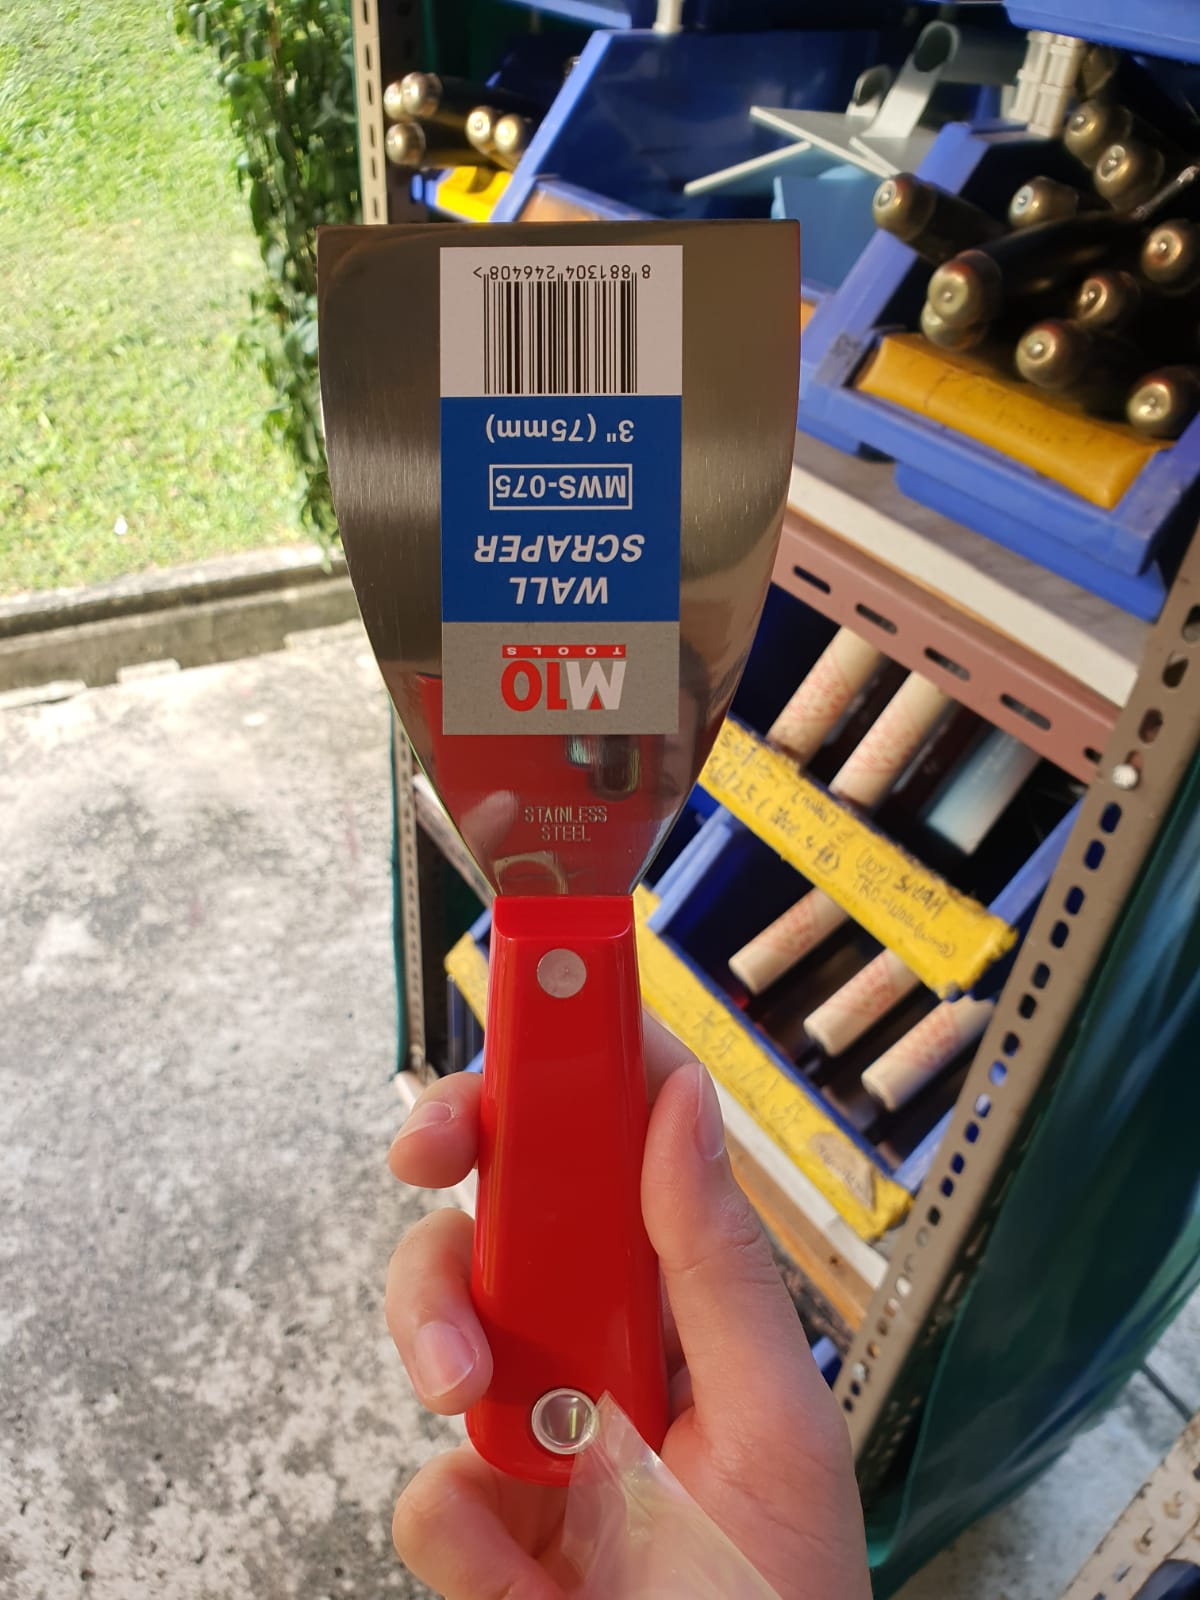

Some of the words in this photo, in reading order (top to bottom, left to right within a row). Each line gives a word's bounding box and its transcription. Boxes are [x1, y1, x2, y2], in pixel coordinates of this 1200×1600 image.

[565, 264, 631, 280] 881304
[641, 264, 651, 279] 8
[485, 413, 597, 443] (75mm)
[606, 419, 635, 442] 3"
[494, 475, 627, 500] MWS-075
[474, 534, 645, 563] SCRAPER
[509, 577, 609, 604] WALL
[505, 645, 623, 657] TOOLS
[500, 660, 627, 712] M10
[524, 805, 608, 824] STAINLESS
[540, 825, 592, 841] STEEL
